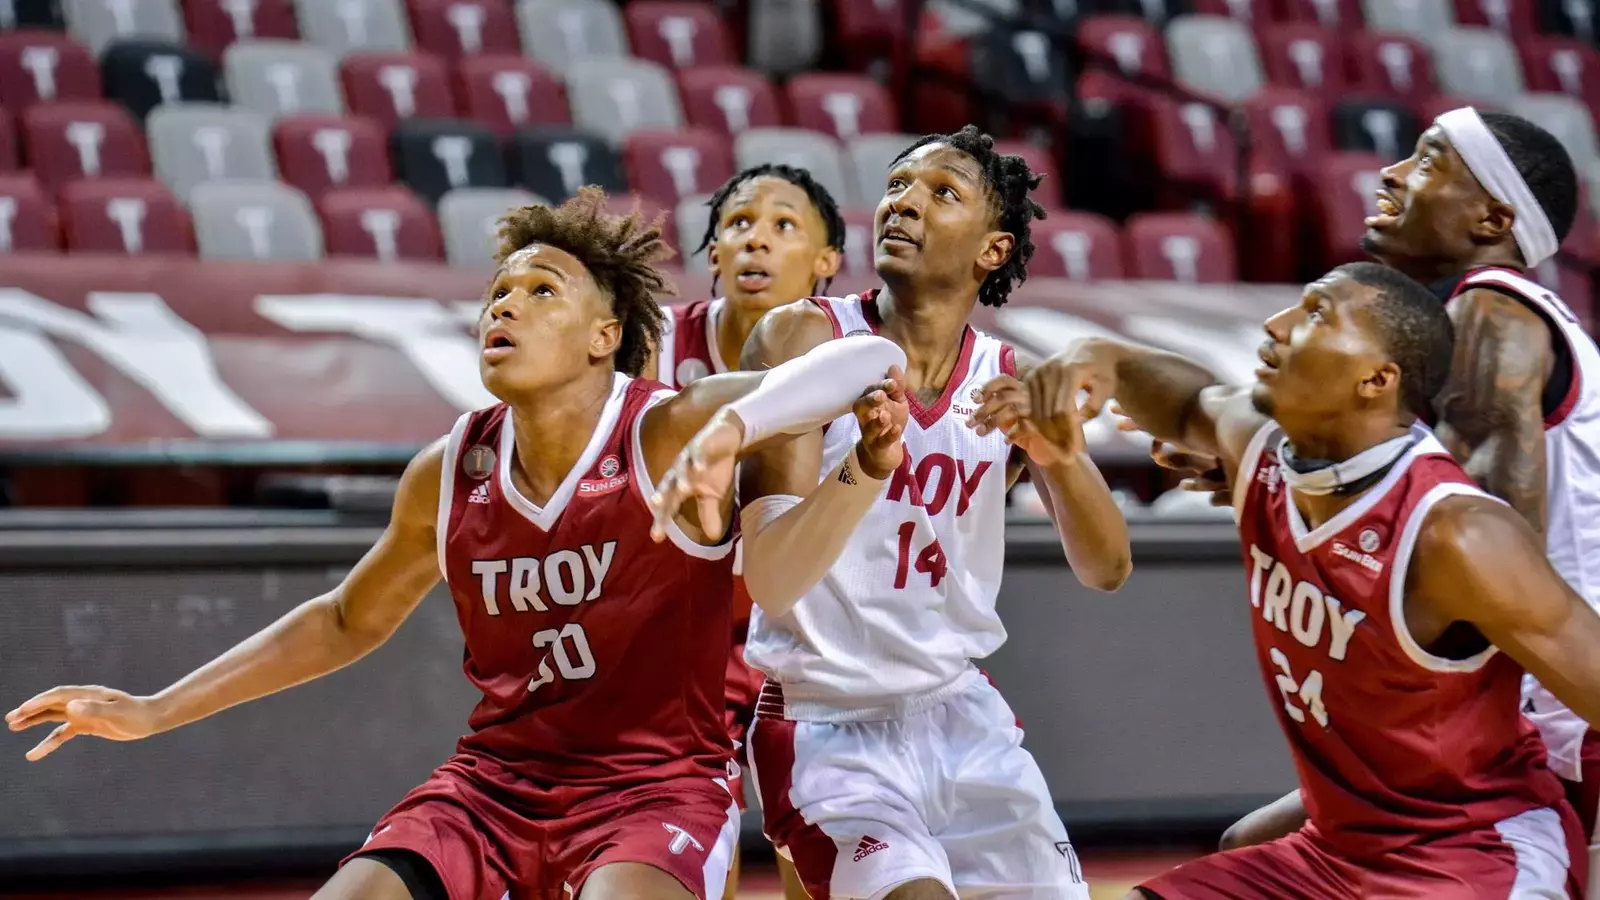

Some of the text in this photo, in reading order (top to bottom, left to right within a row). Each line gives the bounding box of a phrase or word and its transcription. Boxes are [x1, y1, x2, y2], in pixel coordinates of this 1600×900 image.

[472, 541, 617, 616] TROY
[893, 521, 948, 590] 14
[1250, 543, 1367, 661] TROY
[528, 622, 596, 692] 30
[1270, 647, 1329, 728] 24
[853, 842, 889, 862] adidas
